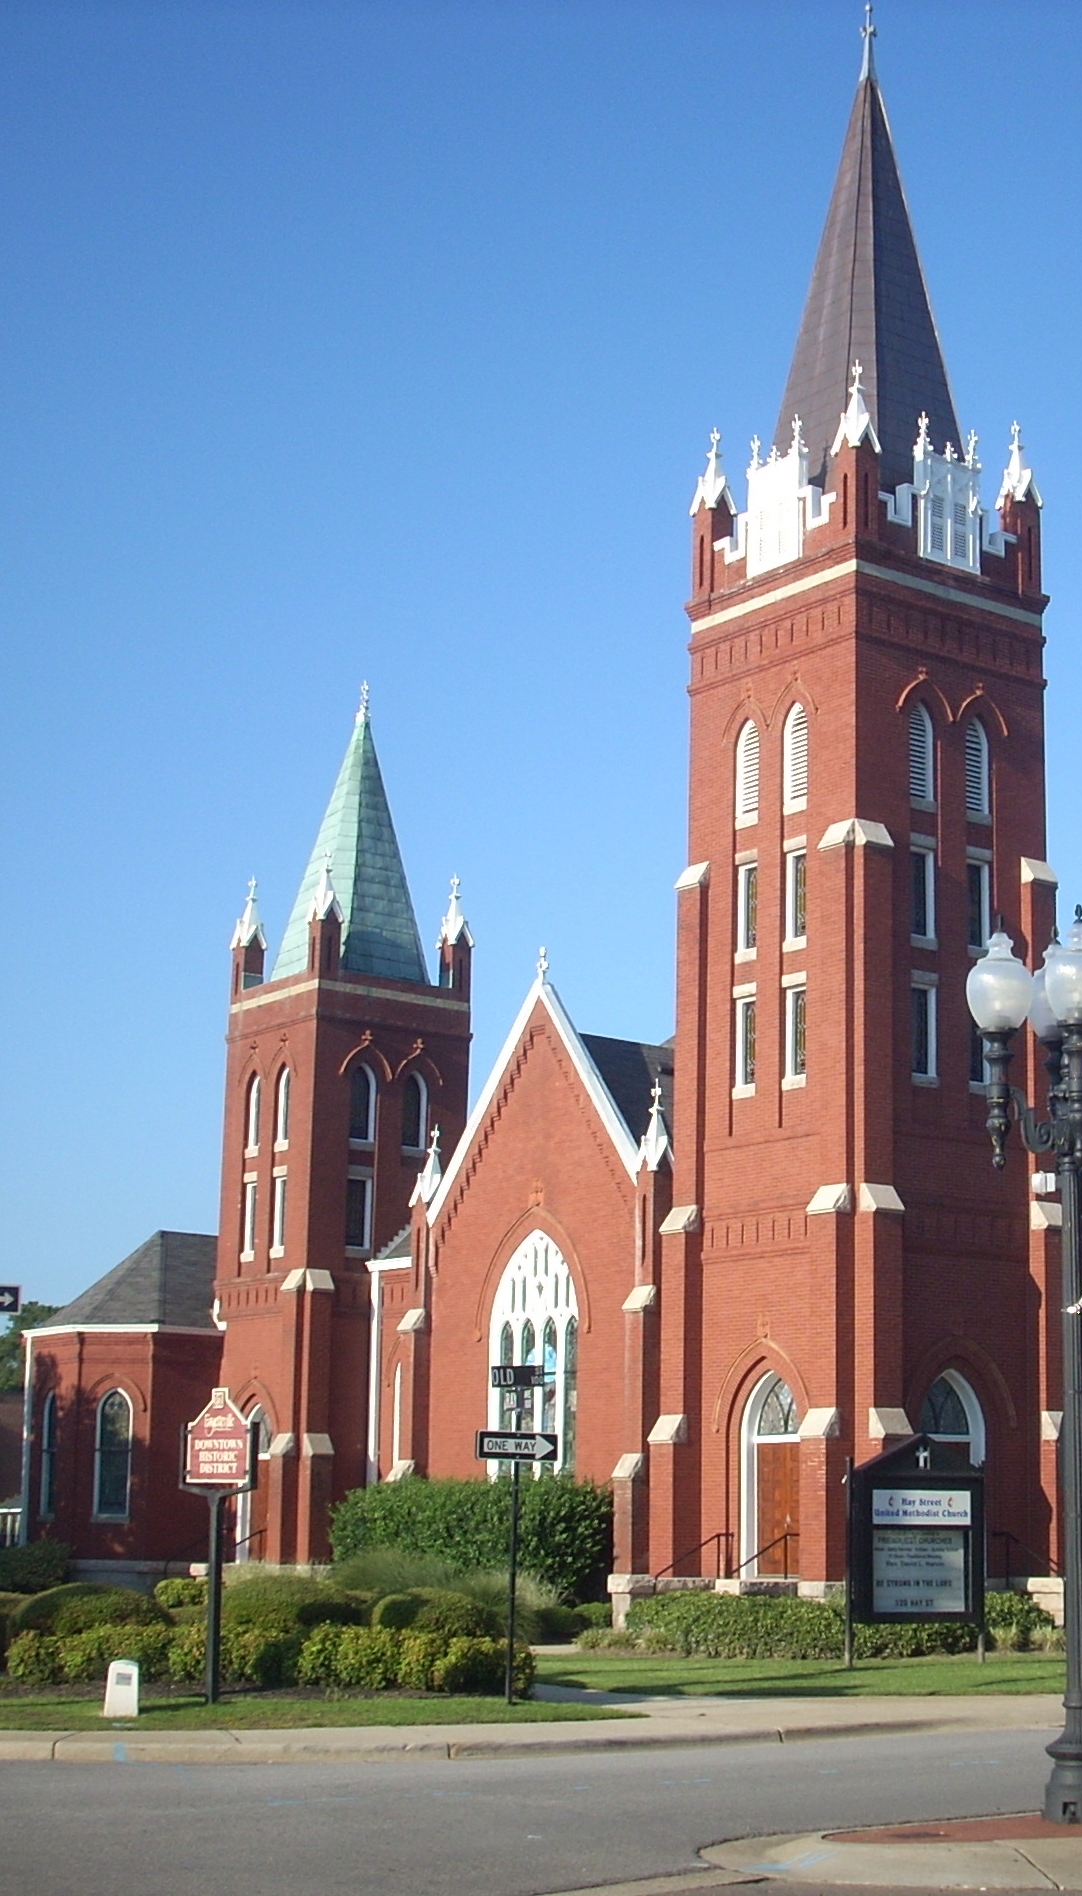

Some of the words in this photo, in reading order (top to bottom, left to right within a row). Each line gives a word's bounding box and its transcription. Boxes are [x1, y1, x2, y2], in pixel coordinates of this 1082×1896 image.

[492, 1368, 515, 1385] OLD
[195, 1440, 243, 1449] DOWNTOWN
[486, 1440, 508, 1451] ONE
[514, 1441, 537, 1452] WAY
[199, 1452, 237, 1461] HISTORIC
[200, 1463, 237, 1473] DISTRICT
[902, 1498, 915, 1506] Hay
[919, 1498, 941, 1506] Street
